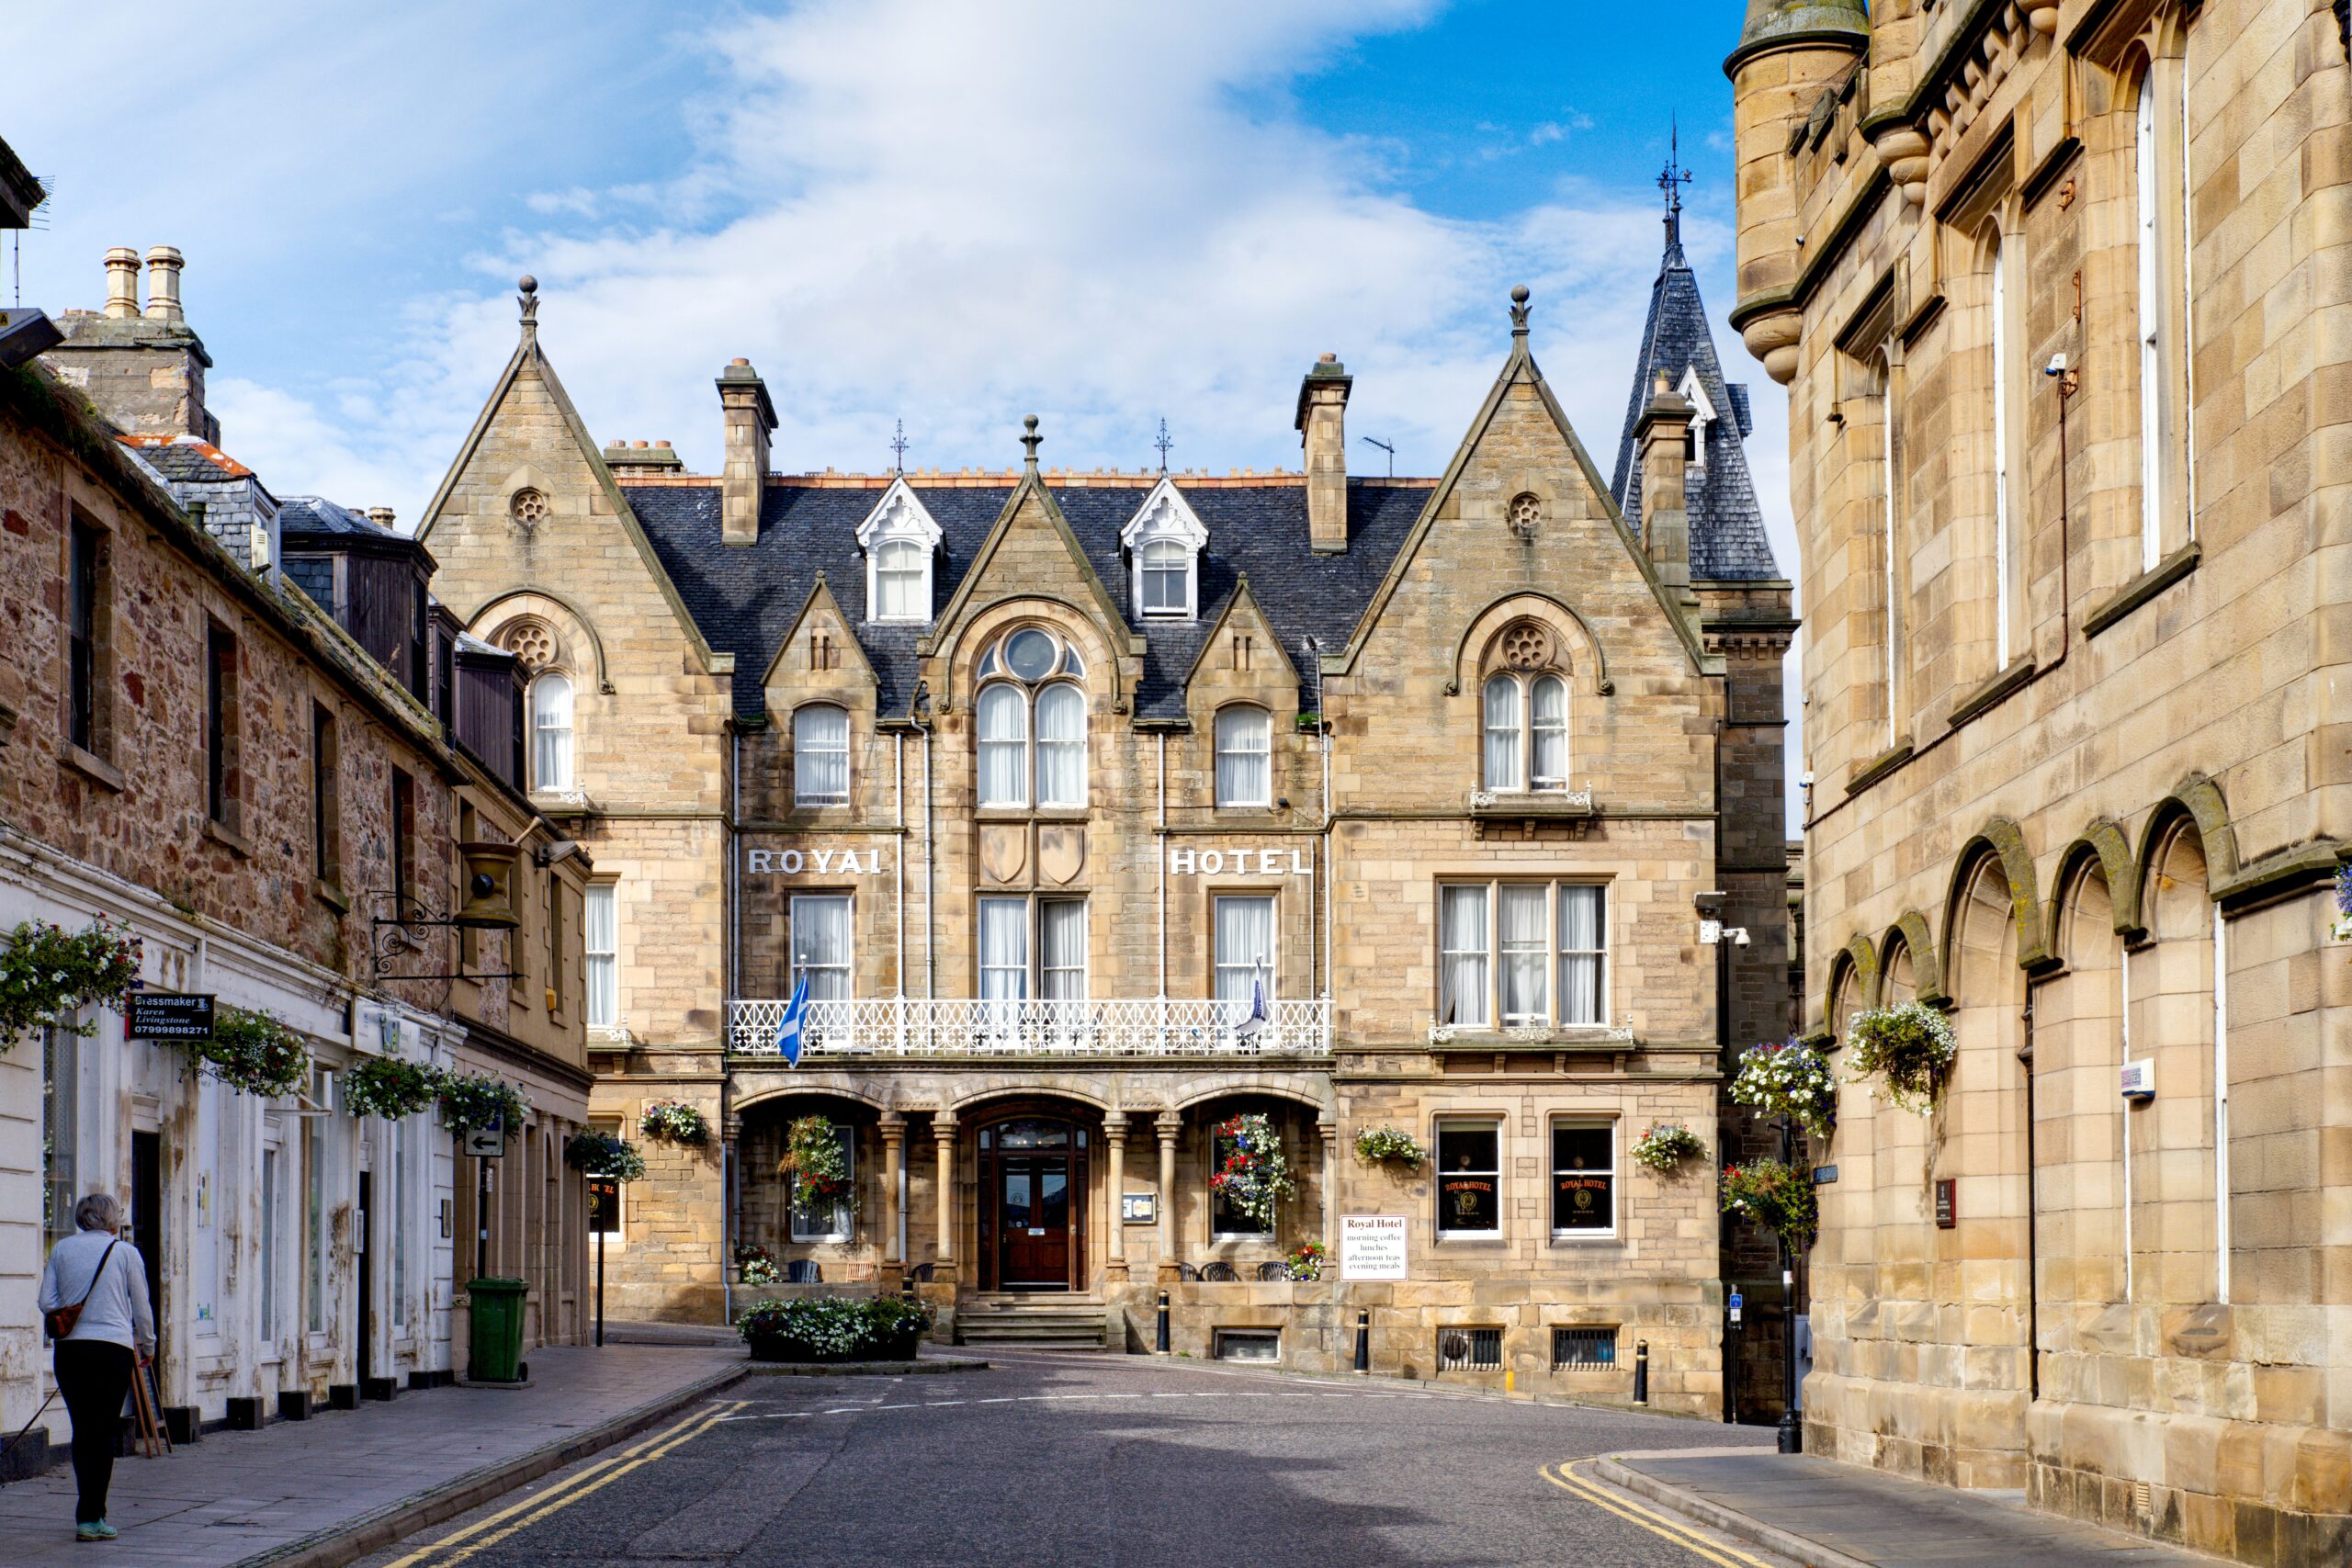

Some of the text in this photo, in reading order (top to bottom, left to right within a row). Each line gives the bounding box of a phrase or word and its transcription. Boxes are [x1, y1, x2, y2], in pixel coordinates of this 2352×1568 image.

[748, 849, 1312, 874] ROYAL HOTEL
[134, 995, 197, 1007] Dressmaker
[135, 1008, 165, 1016] Karen
[135, 1015, 191, 1025] Livingstone
[134, 1025, 209, 1034] 07999898271
[1445, 1180, 1491, 1191] ROYAL HOTEL
[1560, 1179, 1606, 1190] ROYAL HOTEL
[1347, 1219, 1402, 1231] Royal Hotel
[1347, 1233, 1402, 1242] morning coffee
[1349, 1262, 1378, 1270] evening
